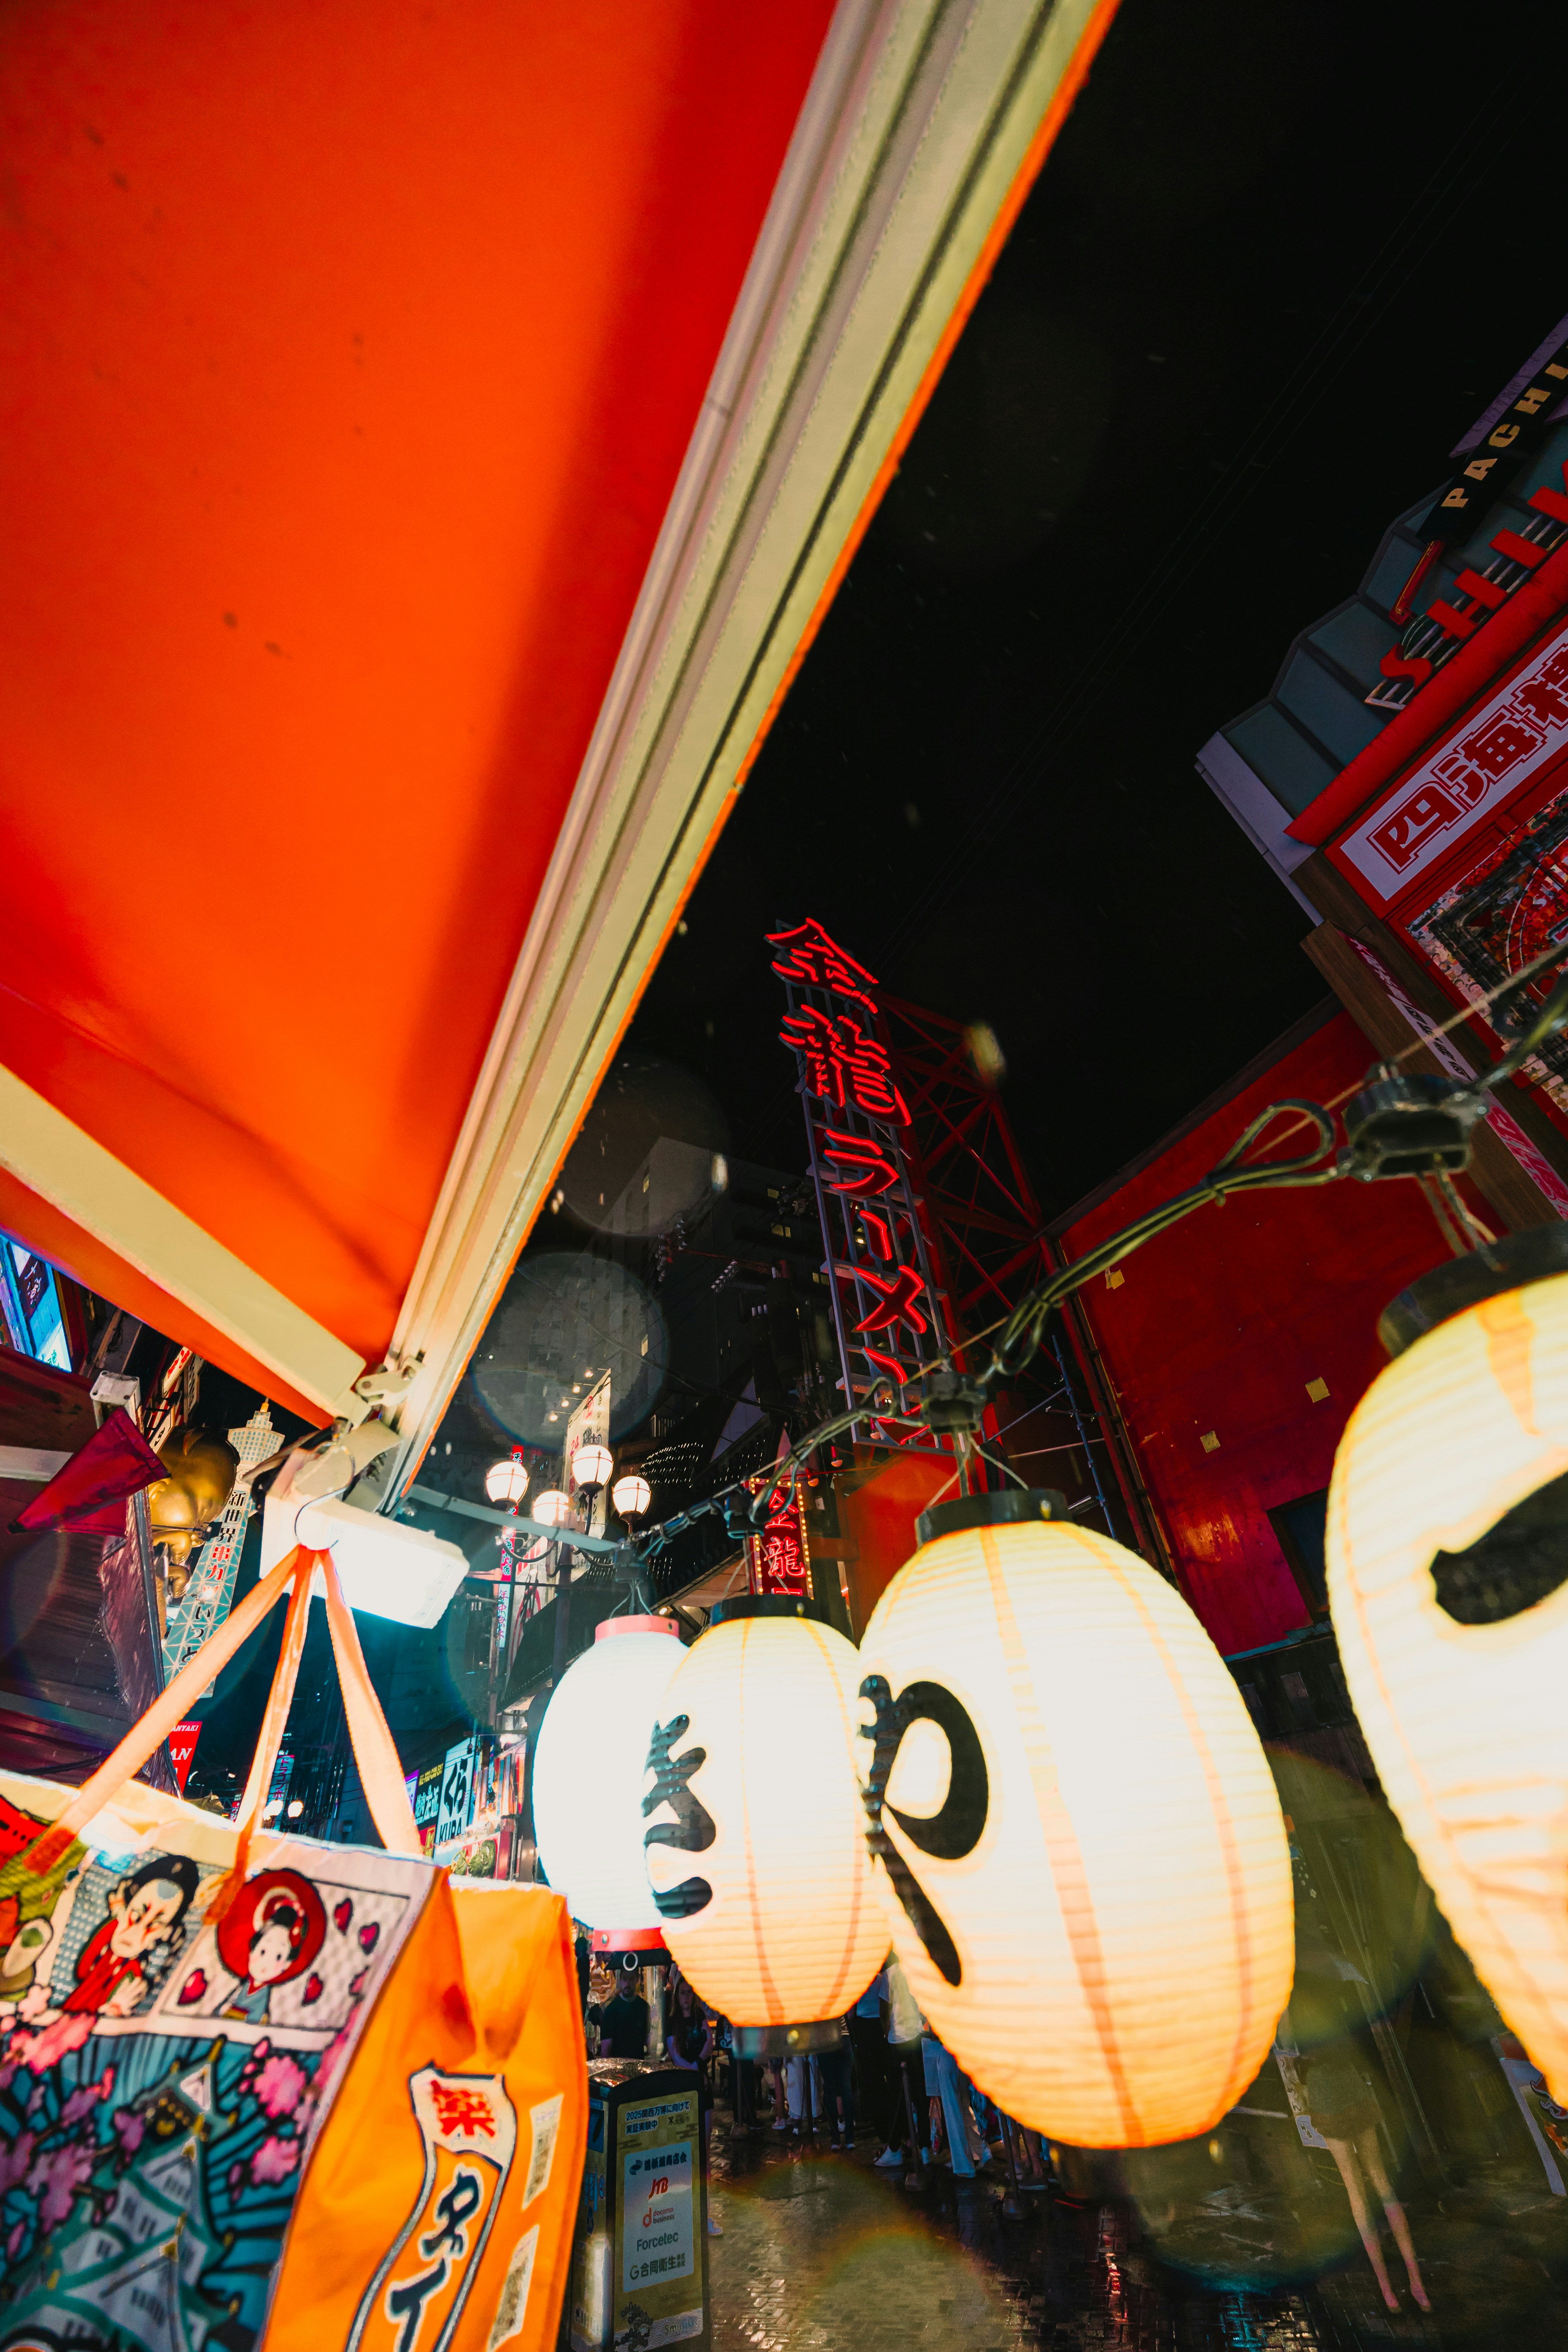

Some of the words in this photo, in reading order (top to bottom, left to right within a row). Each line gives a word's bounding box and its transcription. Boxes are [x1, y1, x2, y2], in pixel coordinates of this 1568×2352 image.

[764, 917, 931, 1447] 金龍ラーメン
[569, 1435, 579, 1496] 24間
[765, 1489, 807, 1595] 金龍
[626, 2101, 690, 2121] 2025関西万博に向けて
[674, 2116, 690, 2126] 大阪市
[626, 2119, 658, 2135] 実証実験中
[648, 2176, 669, 2200] JTB
[653, 2207, 674, 2217] docomo
[653, 2214, 675, 2224] business
[637, 2232, 679, 2252] Forcetec
[640, 2255, 676, 2277] 合同衛生
